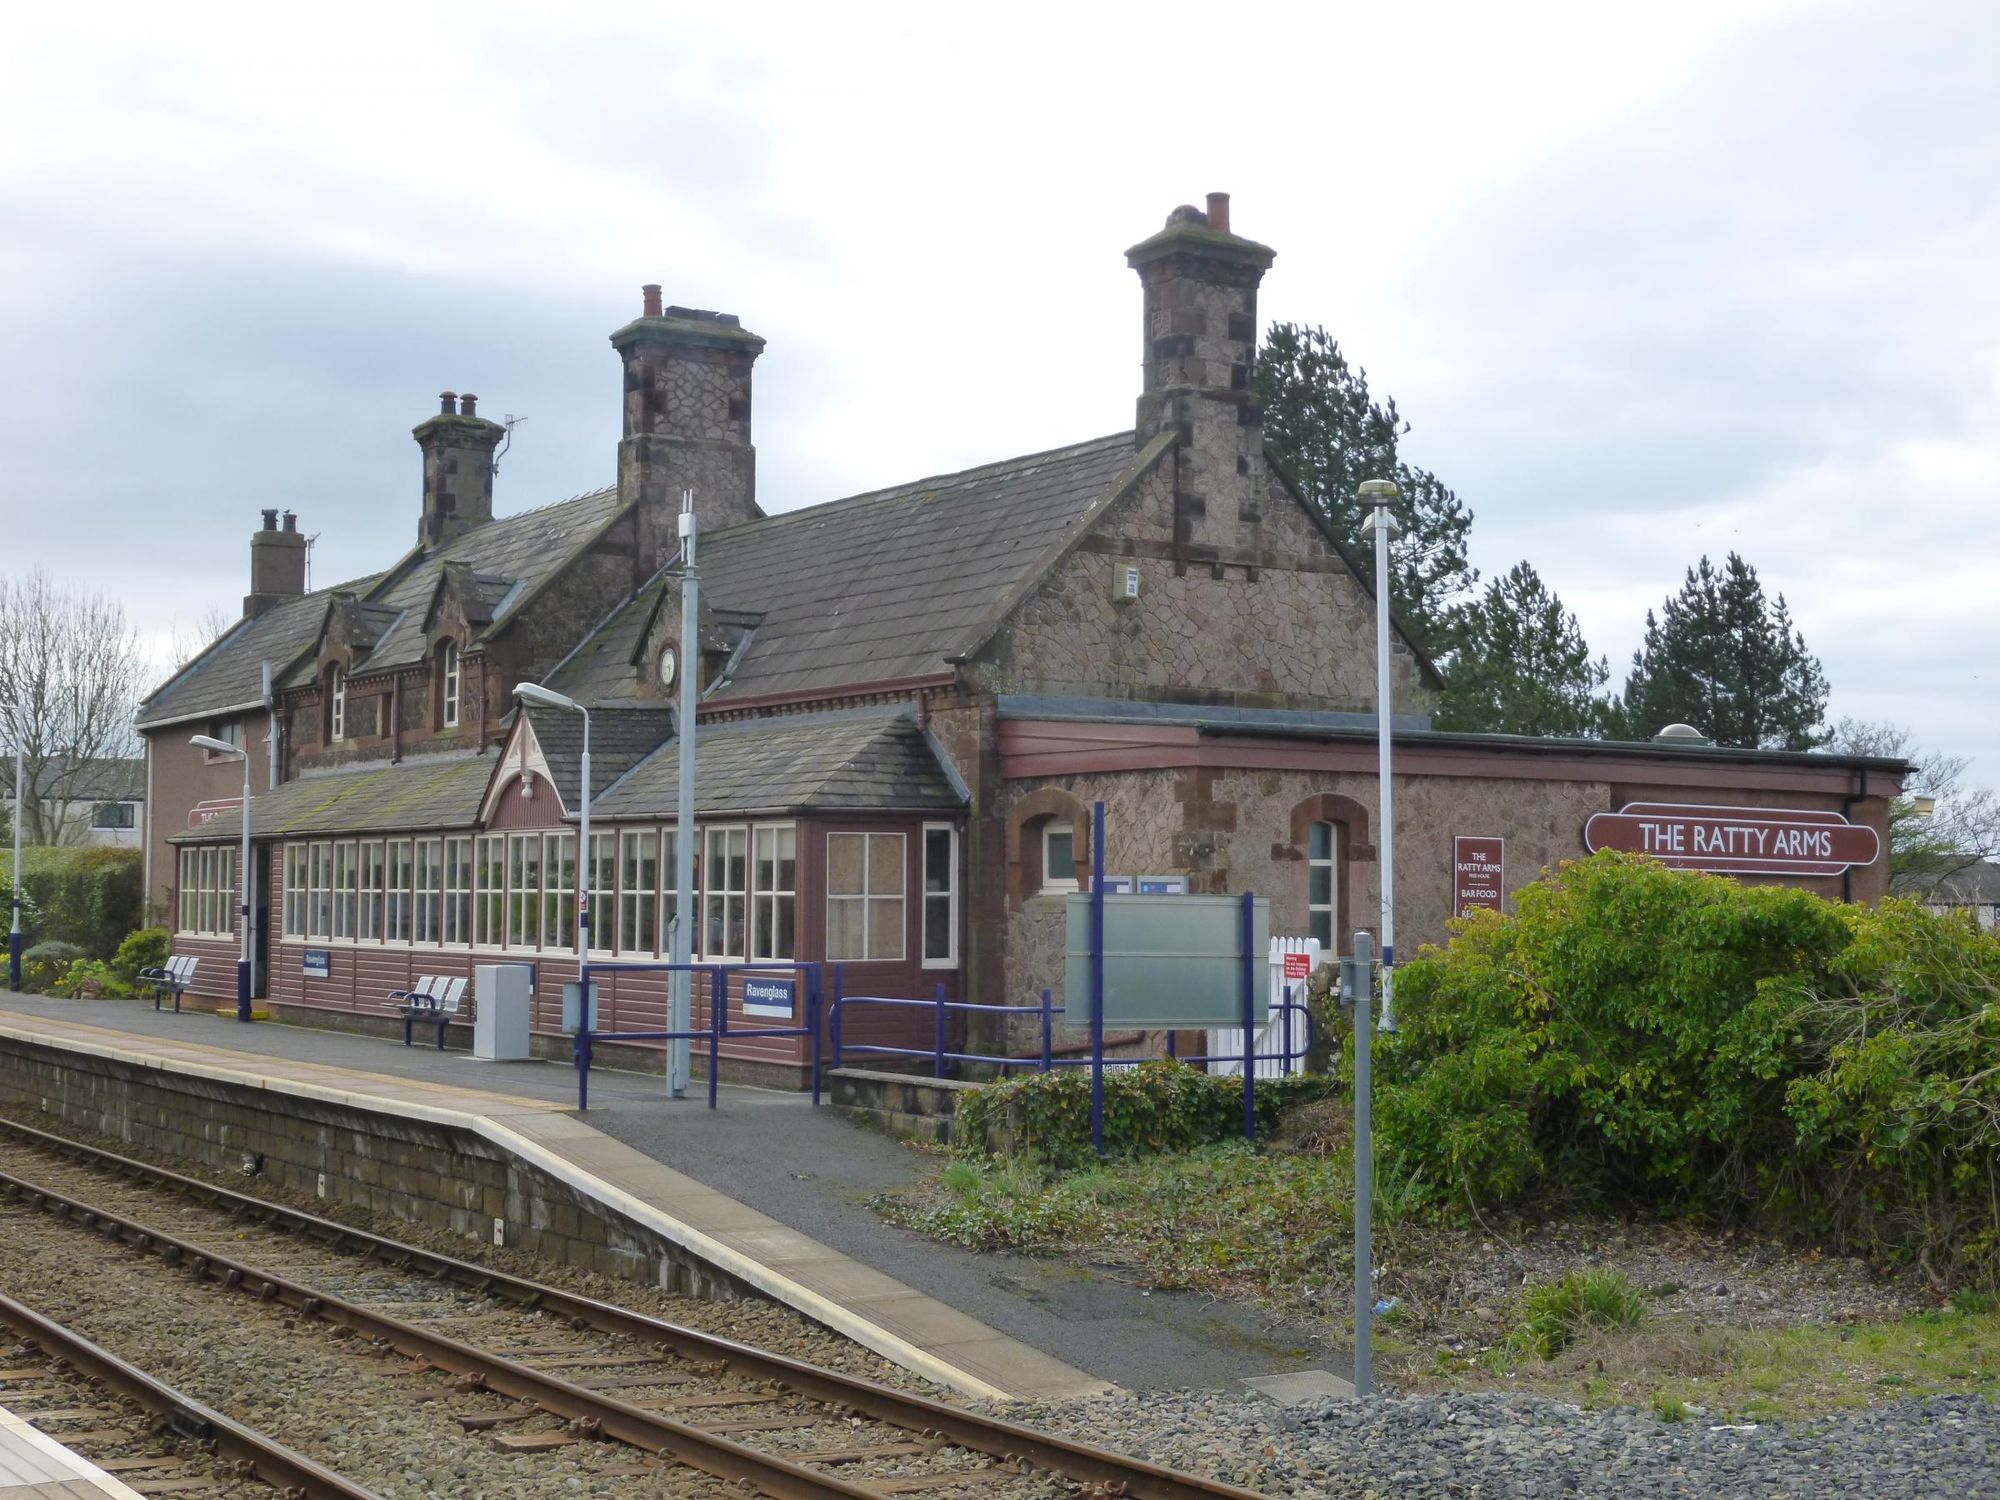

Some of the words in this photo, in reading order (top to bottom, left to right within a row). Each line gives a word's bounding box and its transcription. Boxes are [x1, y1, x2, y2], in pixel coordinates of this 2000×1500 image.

[1639, 823, 1685, 851] THE
[1694, 826, 1769, 854] RATTY
[1773, 830, 1832, 857] ARMS
[1471, 852, 1487, 861] THE
[1457, 863, 1481, 872] RATTY
[1482, 864, 1501, 873] ARMS
[1461, 889, 1475, 898] BAR
[1476, 890, 1497, 898] FOOD
[746, 983, 788, 1001] Ravenglass
